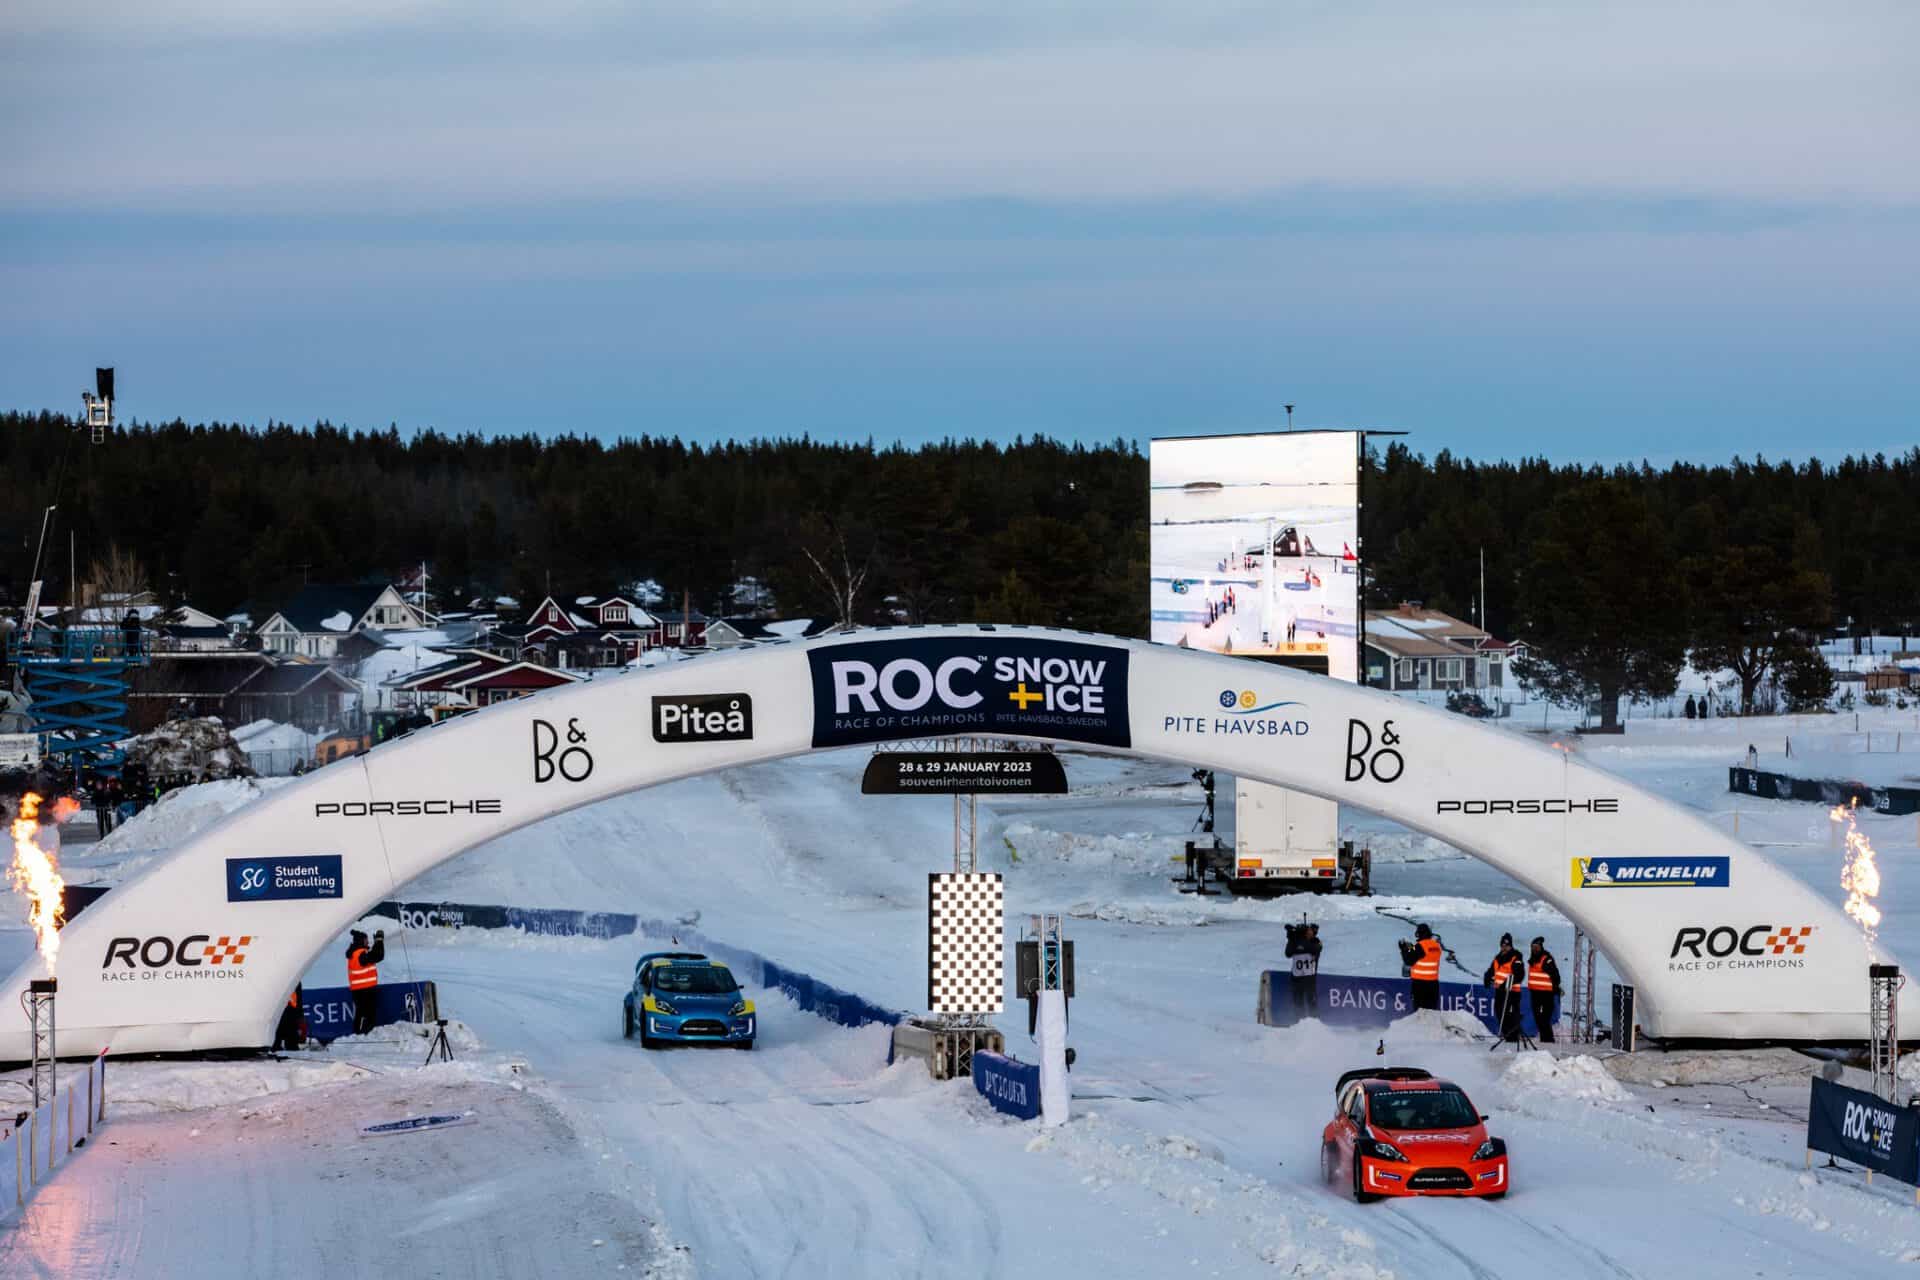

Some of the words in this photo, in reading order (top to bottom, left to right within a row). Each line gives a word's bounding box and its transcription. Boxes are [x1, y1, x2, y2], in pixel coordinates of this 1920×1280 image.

[994, 656, 1106, 686] SNOW
[832, 656, 984, 714] ROC
[660, 700, 745, 735] Piteå
[835, 718, 870, 728] RACE
[876, 716, 896, 727] OF
[901, 712, 985, 727] CHAMPIONS
[1164, 717, 1206, 733] PITE
[1214, 719, 1309, 736] HAVSBAD
[899, 762, 914, 772] 28
[916, 763, 924, 772] &
[926, 762, 941, 772] 29
[944, 762, 1000, 772] JANUARY
[1003, 761, 1032, 772] 2023
[316, 800, 501, 817] PORSCHE
[1437, 799, 1619, 815] PORSCHE
[275, 866, 319, 876] Student
[1616, 865, 1718, 880] MICHELIN
[275, 876, 336, 889] Consulting
[400, 910, 439, 929] ROC
[1670, 925, 1773, 959] ROC
[102, 935, 210, 969] ROC
[1668, 962, 1700, 973] RACE
[1706, 961, 1724, 970] OF
[1728, 959, 1805, 969] CHAMPIONS
[102, 971, 136, 982] RACE
[142, 970, 159, 981] OF
[164, 969, 245, 981] CHAMPIONS
[1329, 988, 1386, 1010] BANG
[1394, 992, 1406, 1010] &
[1842, 1101, 1872, 1143] ROC
[1873, 1108, 1897, 1131] SNOW
